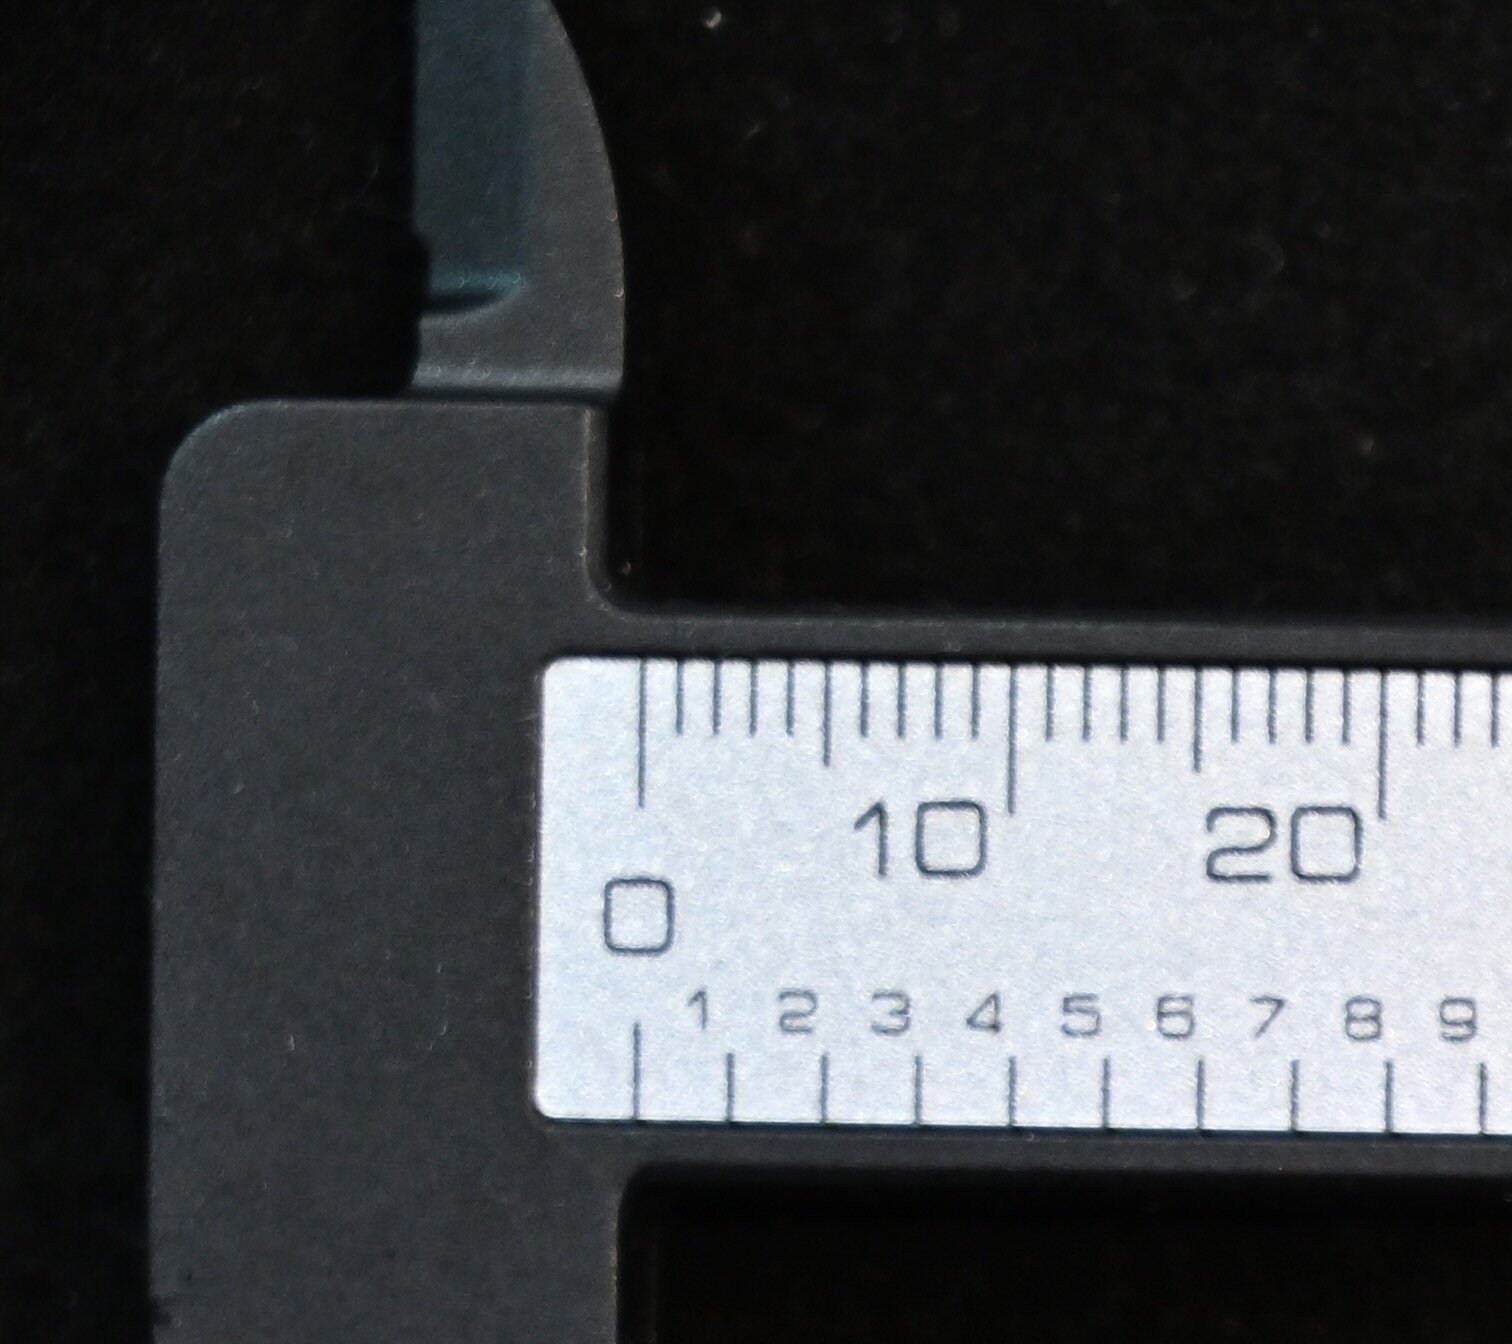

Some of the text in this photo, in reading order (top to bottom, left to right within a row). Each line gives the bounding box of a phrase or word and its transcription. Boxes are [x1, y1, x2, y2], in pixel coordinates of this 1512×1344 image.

[853, 797, 989, 881] 10
[1203, 803, 1365, 886] 20
[600, 874, 676, 958] 0
[688, 987, 709, 1030] 1
[777, 988, 818, 1035] 2
[870, 989, 912, 1037] 3
[965, 991, 1003, 1035] 4
[1060, 993, 1102, 1039] 5
[1154, 993, 1196, 1041] 6
[1251, 994, 1287, 1038] 7
[1343, 995, 1383, 1043] 8
[1438, 996, 1478, 1045] 9
